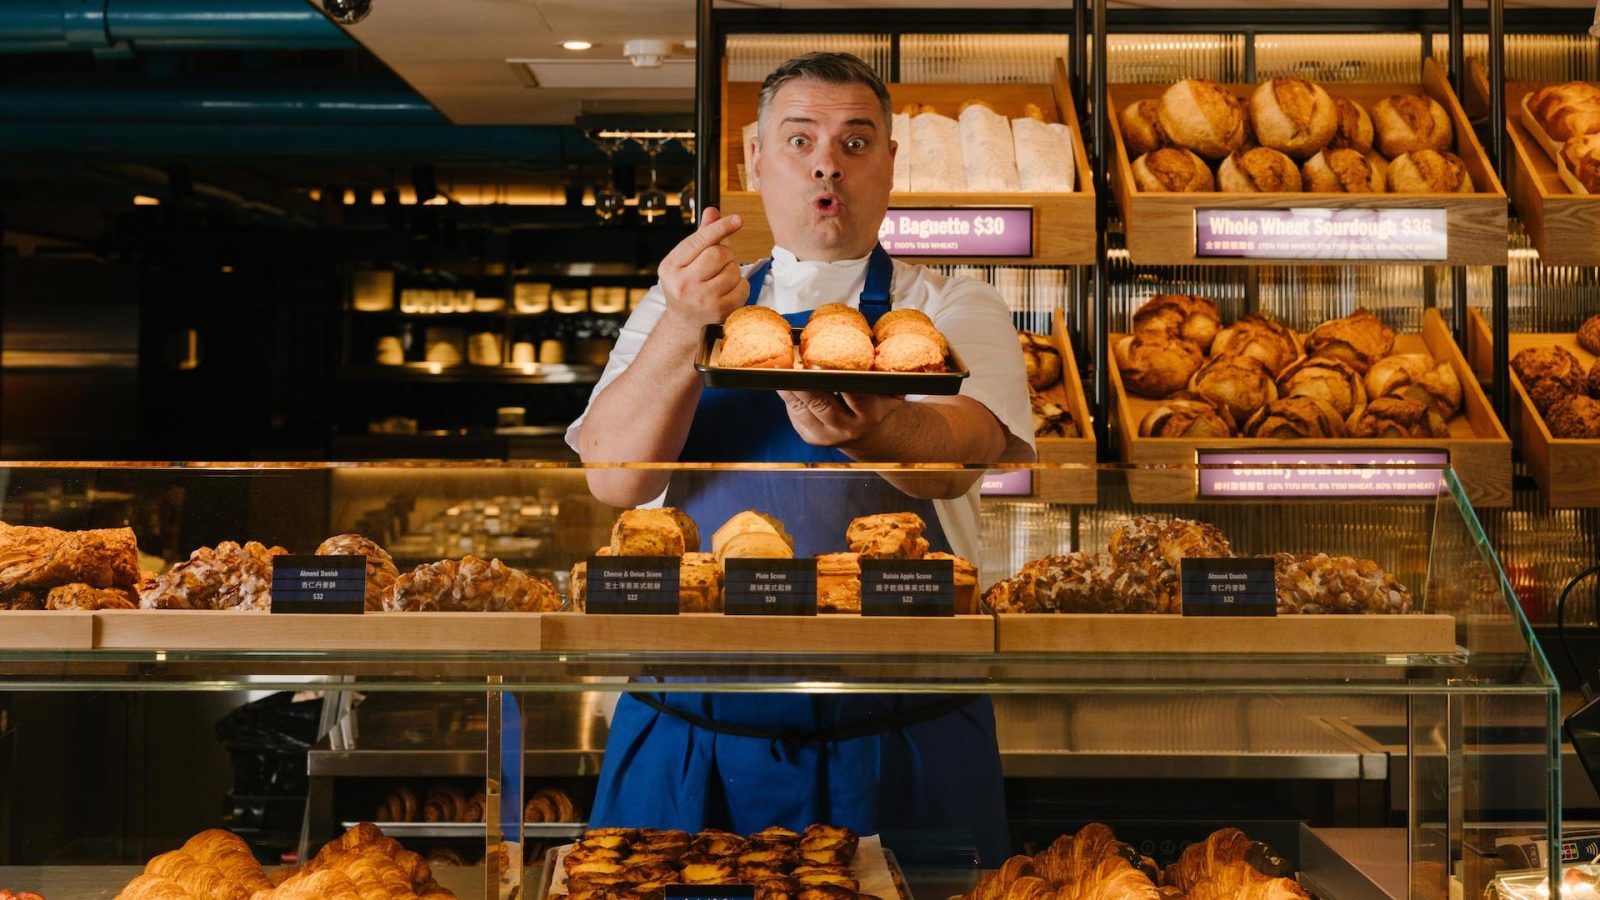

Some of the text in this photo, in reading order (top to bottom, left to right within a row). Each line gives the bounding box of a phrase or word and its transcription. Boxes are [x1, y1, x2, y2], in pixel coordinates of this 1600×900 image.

[900, 216, 970, 238] Baguette
[974, 215, 1005, 237] $30
[1209, 216, 1432, 240] Whole Wheat Sourdough $36
[931, 241, 958, 250] WHEAT)
[1407, 482, 1435, 490] WHEAT)
[755, 572, 786, 580] Plain Scone
[883, 572, 932, 581] Raisin Apple Scone
[1208, 572, 1248, 580] Almond Danish
